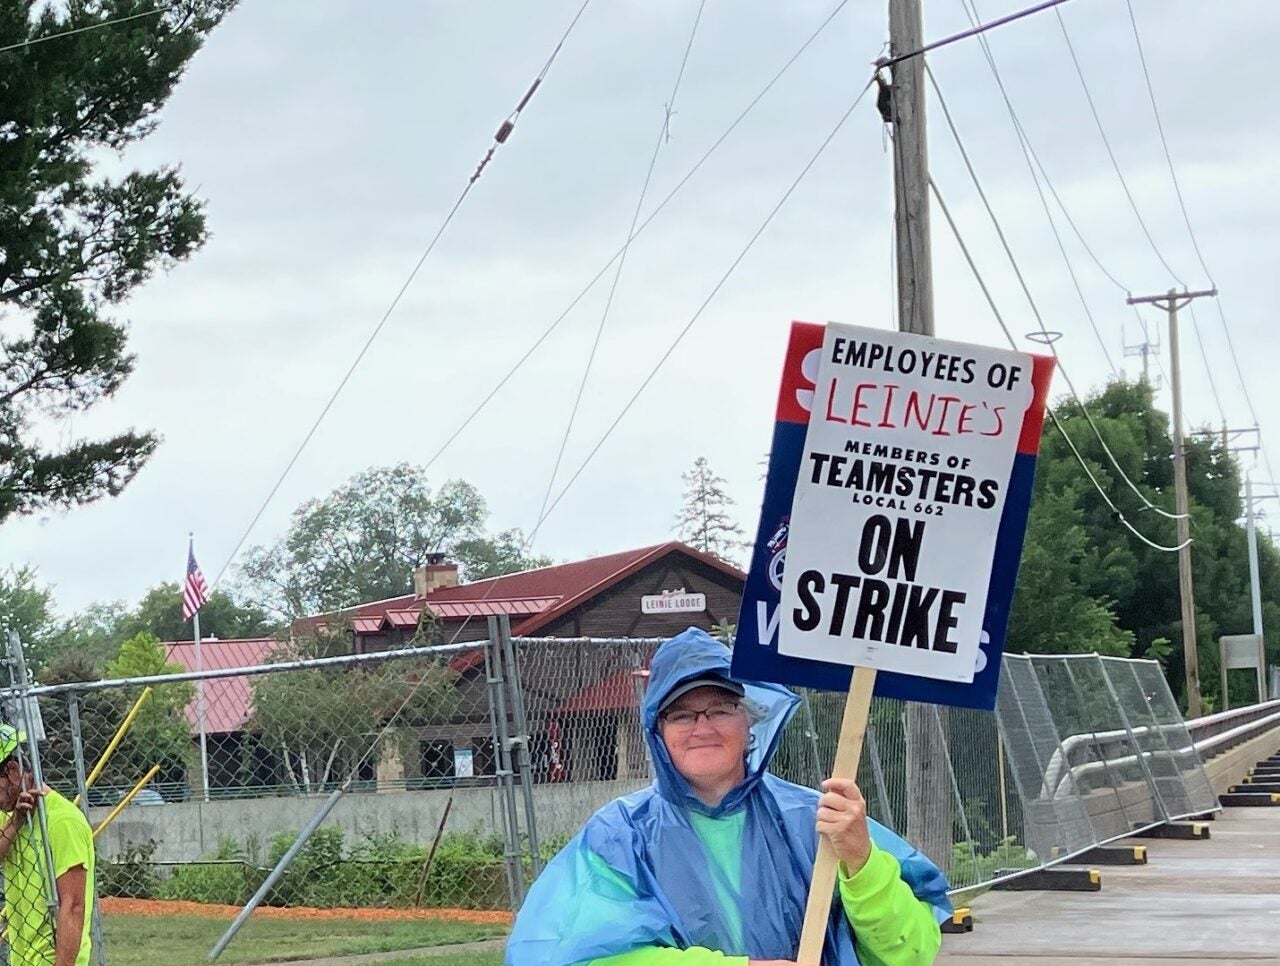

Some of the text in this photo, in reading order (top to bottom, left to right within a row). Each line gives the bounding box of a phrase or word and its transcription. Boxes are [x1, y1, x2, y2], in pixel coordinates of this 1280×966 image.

[831, 337, 976, 384] EMPLOYEES
[987, 363, 1022, 391] OF
[825, 378, 1007, 437] LEINIE'S
[809, 452, 999, 509] TEAMSTERS
[844, 440, 972, 470] MEMBERS OF
[852, 493, 944, 516] LOCAL 662
[857, 514, 926, 582] ON
[646, 598, 701, 609] LEINIE LODGE
[792, 570, 967, 654] STRIKE
